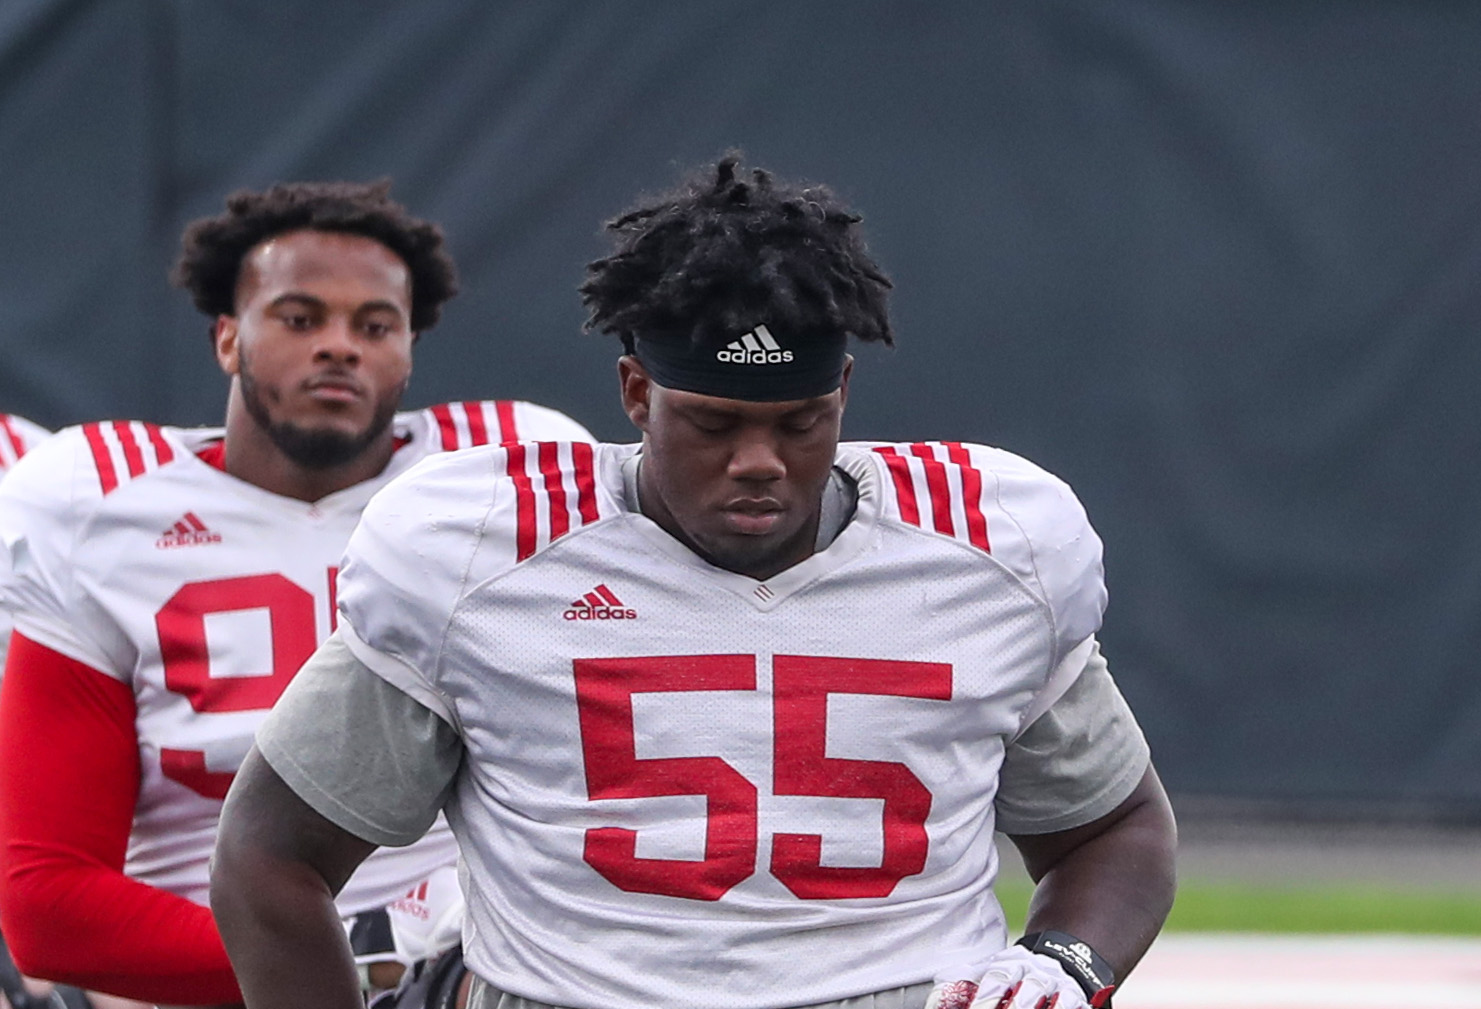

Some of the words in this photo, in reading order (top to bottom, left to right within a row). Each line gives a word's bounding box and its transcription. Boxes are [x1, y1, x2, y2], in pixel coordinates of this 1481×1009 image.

[717, 349, 794, 364] adidas
[563, 605, 637, 620] adidas
[155, 566, 342, 800] 9
[573, 653, 953, 900] 55
